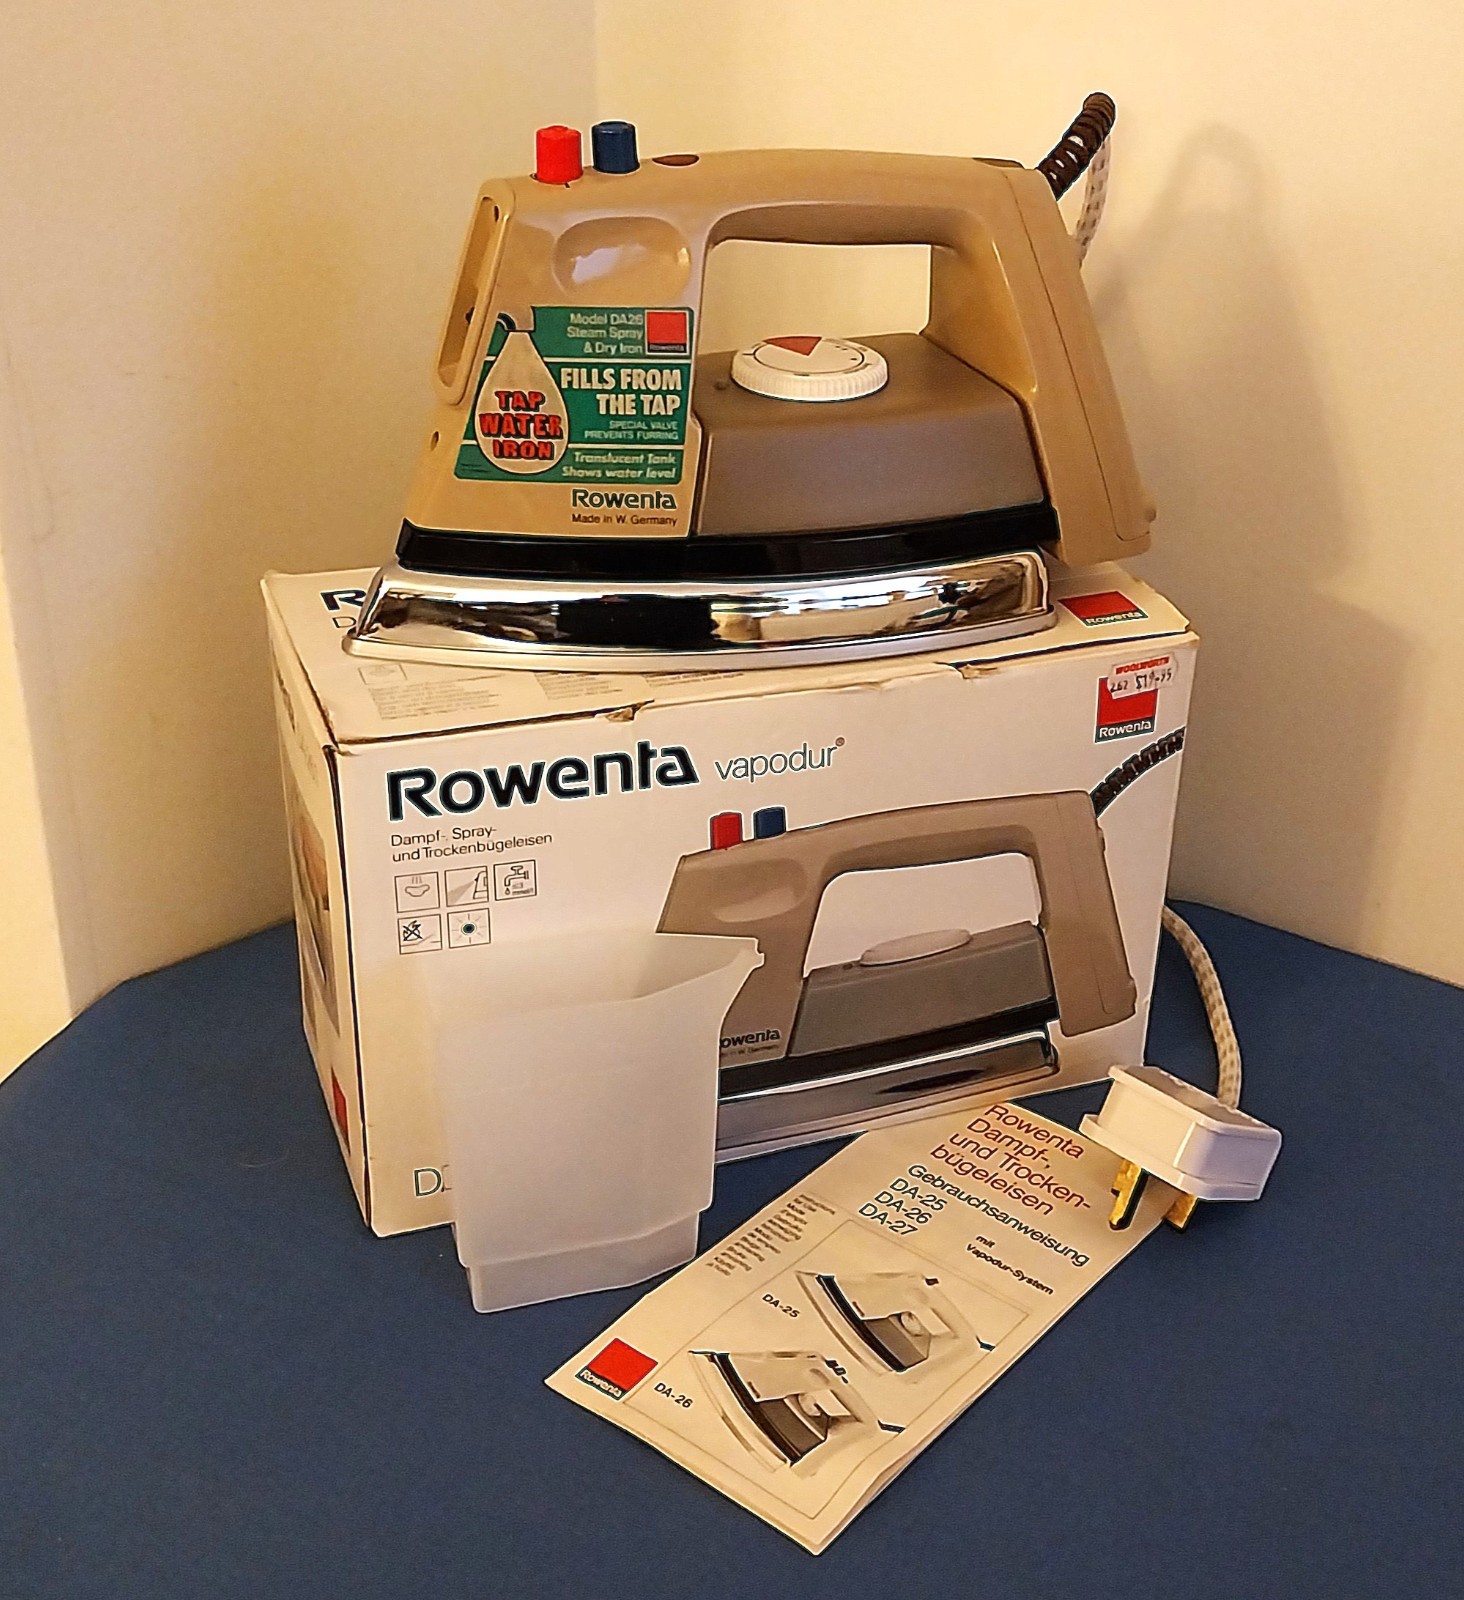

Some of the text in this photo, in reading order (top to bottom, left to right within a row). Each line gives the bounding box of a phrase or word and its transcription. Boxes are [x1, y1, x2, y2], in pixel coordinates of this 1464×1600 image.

[570, 313, 608, 326] Model
[567, 327, 644, 341] Steam Spray
[583, 343, 644, 356] & Dry Iron
[560, 368, 682, 391] FILLS FROM
[494, 390, 546, 412] TAP
[596, 394, 681, 416] THE TAP
[479, 413, 564, 440] WATER
[584, 430, 679, 441] PREVENTS FURRING
[609, 420, 678, 431] SPECIAL VALVE
[492, 439, 555, 460] IRON
[574, 452, 676, 465] Translucent Tank
[561, 467, 676, 479] Shows water level
[571, 488, 677, 510] Rowenta
[571, 514, 601, 524] Made
[603, 514, 613, 524] in
[630, 515, 678, 527] Germany
[1085, 611, 1143, 624] Rowenta
[1099, 720, 1152, 738] Rowenta
[386, 740, 700, 821] Rowenta
[452, 826, 498, 841] Spray-
[392, 848, 421, 863] und
[719, 1029, 781, 1048] owenta
[984, 1104, 1085, 1160] Rowenta
[930, 1144, 1054, 1216] bügeleisen
[949, 1132, 1091, 1210] und Trocken-
[889, 1178, 948, 1212] DA-25
[874, 1190, 933, 1224] DA-26
[907, 1164, 1090, 1267] Gebrauchsanweisung
[858, 1202, 918, 1236] DA-27
[975, 1235, 996, 1248] mit
[966, 1243, 1054, 1295] Vapodur-System
[762, 1293, 800, 1318] DA-25
[580, 1369, 622, 1397] Rowenta
[654, 1382, 693, 1408] DA-26
